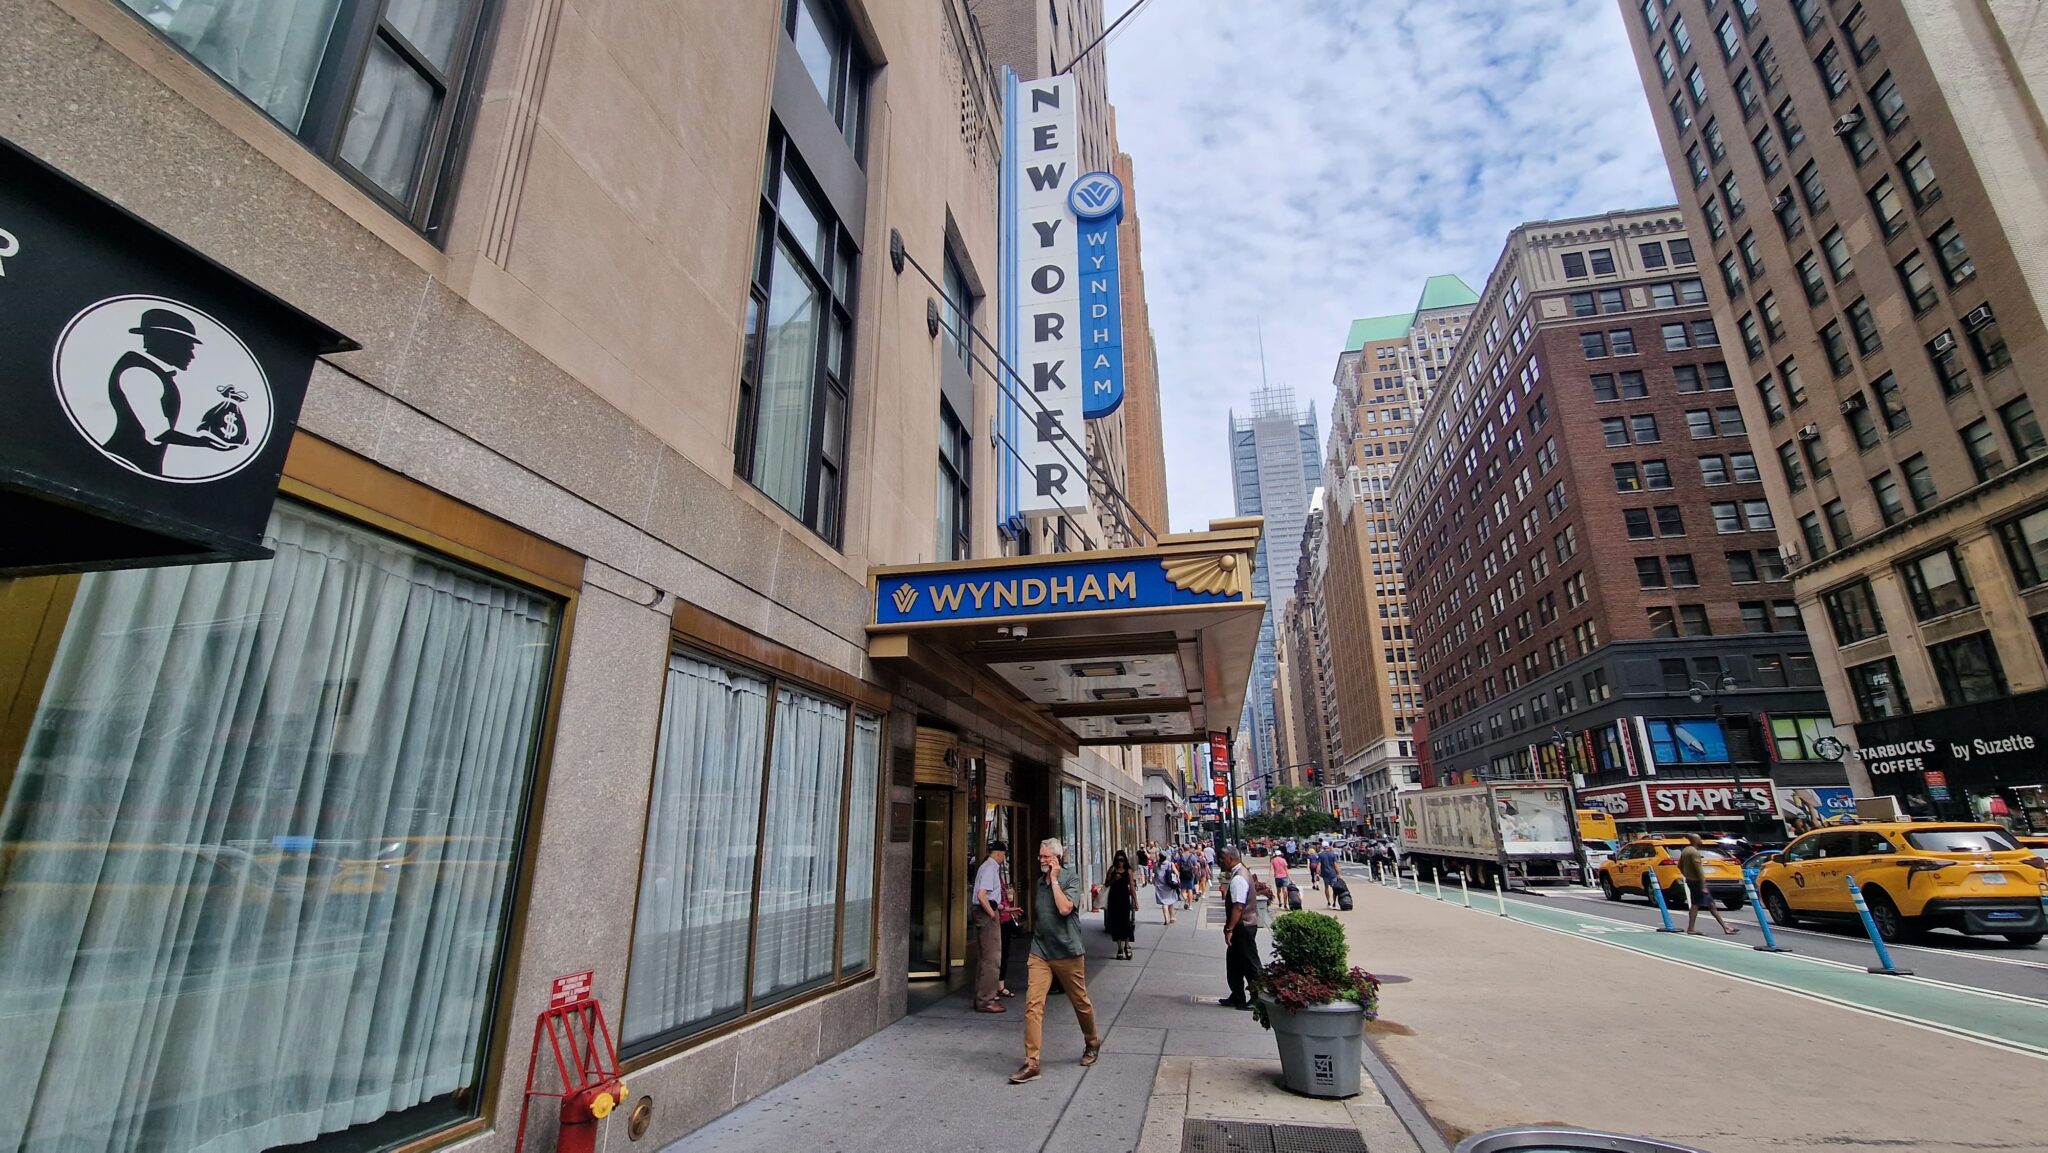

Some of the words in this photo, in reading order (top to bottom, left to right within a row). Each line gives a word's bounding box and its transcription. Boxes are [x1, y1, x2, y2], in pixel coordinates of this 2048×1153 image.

[1026, 85, 1067, 191] NEW
[1086, 231, 1112, 395] WYNDHAM
[1031, 219, 1069, 496] YORKER
[928, 571, 1137, 613] WYNDHAM
[1853, 739, 1936, 761] STARBUCKS
[1951, 742, 1970, 761] by
[1973, 734, 2036, 756] Suzette
[1871, 757, 1925, 775] COFFEE
[1655, 787, 1771, 812] STAPLS
